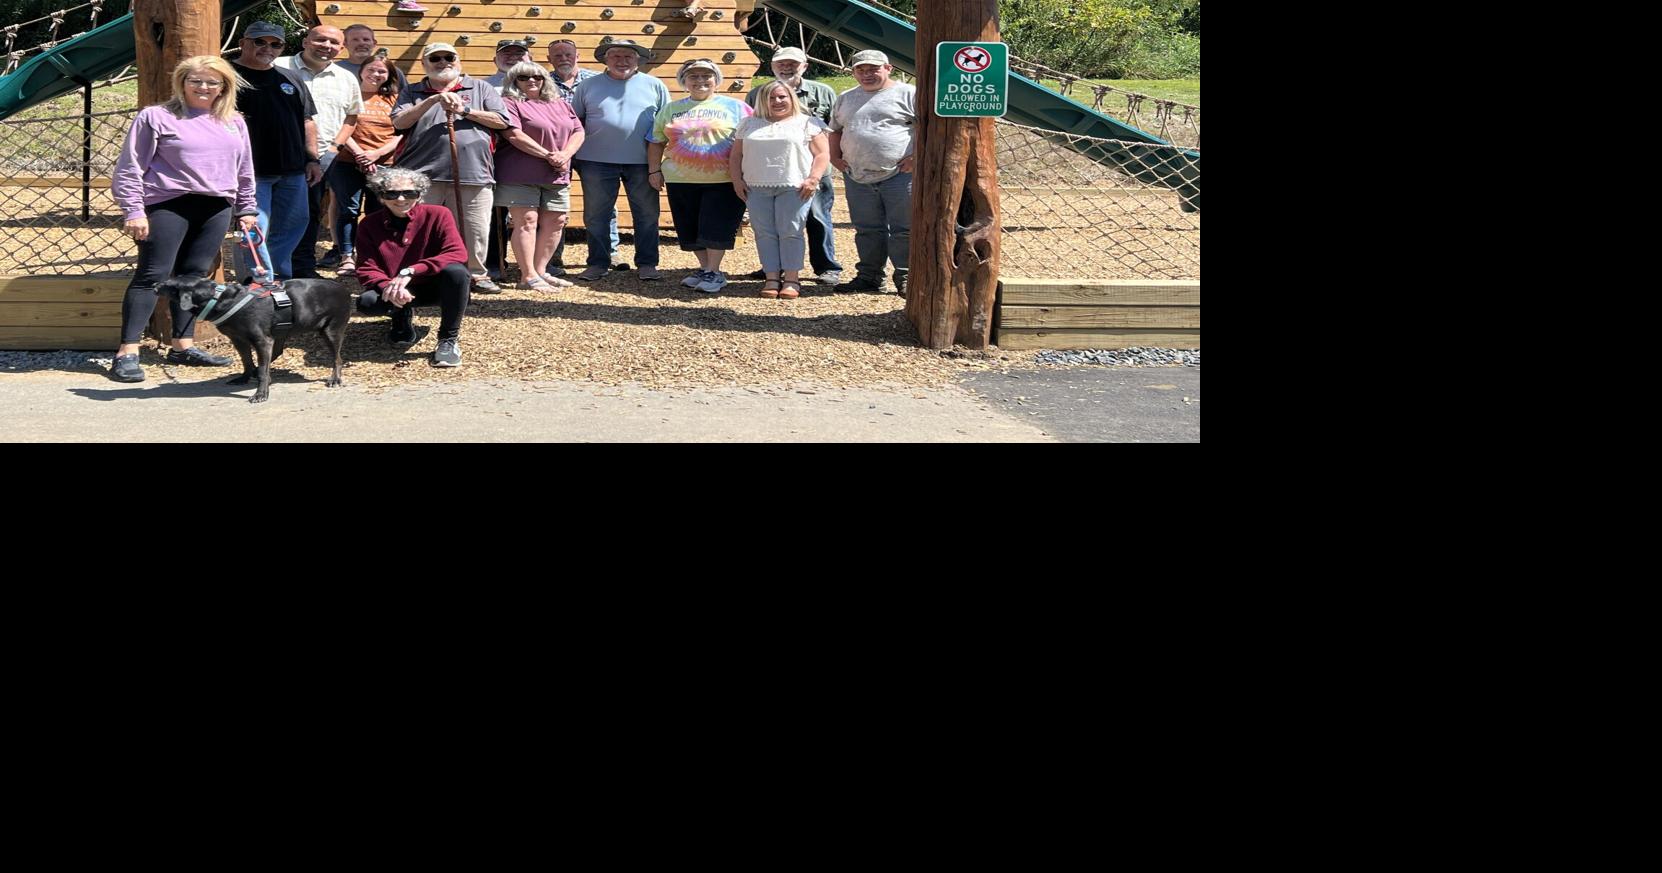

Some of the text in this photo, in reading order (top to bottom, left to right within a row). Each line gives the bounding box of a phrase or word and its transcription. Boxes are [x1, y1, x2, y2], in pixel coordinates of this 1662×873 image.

[960, 74, 984, 83] NO
[948, 84, 995, 93] DOGS
[943, 94, 986, 102] ALLOWED
[939, 102, 1002, 110] PLAYGROUND
[698, 109, 727, 120] CANYON
